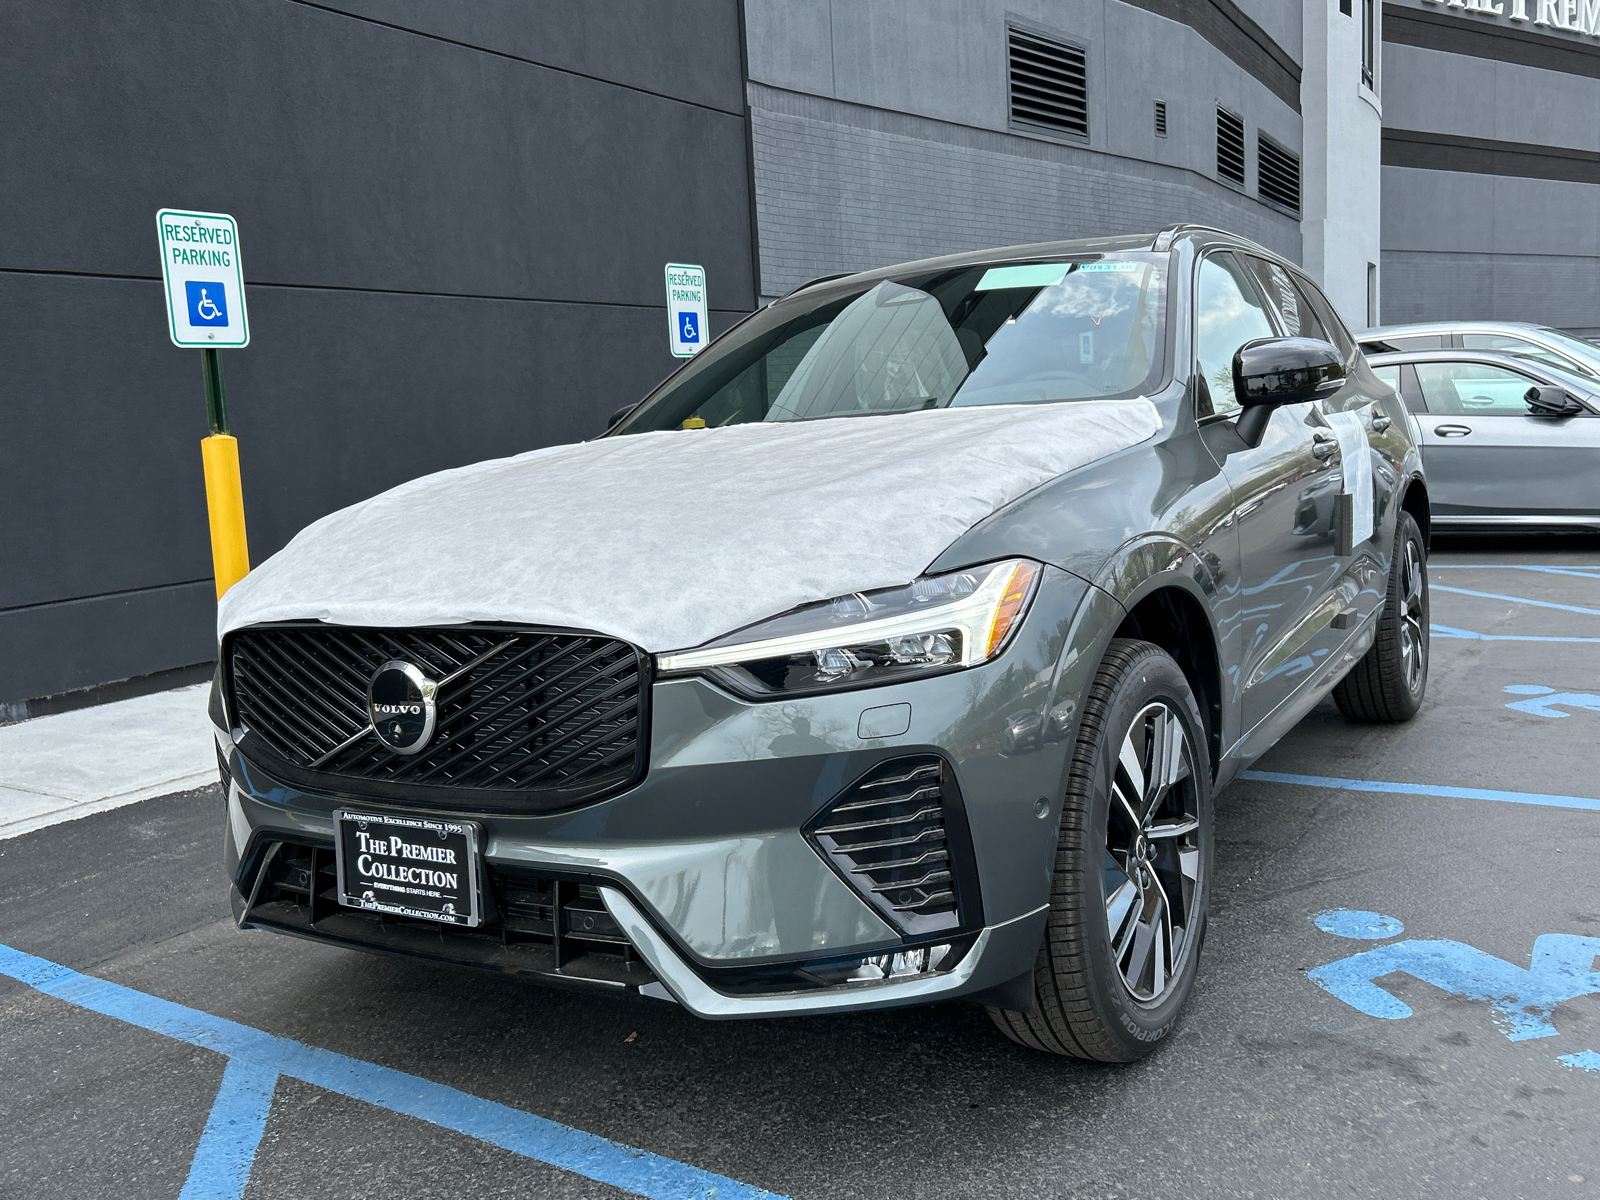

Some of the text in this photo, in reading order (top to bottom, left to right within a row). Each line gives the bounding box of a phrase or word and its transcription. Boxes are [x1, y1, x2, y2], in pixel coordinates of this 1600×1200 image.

[165, 224, 232, 245] RESERVED
[172, 248, 231, 267] PARKING
[669, 274, 702, 287] RESERVED
[672, 290, 701, 303] PARKING
[374, 703, 421, 715] VOLVO
[444, 824, 462, 833] 1995
[356, 831, 457, 865] THE PREMIER
[357, 854, 458, 889] COLLECTION
[373, 882, 442, 898] EVERYTHING STARTS HERE.
